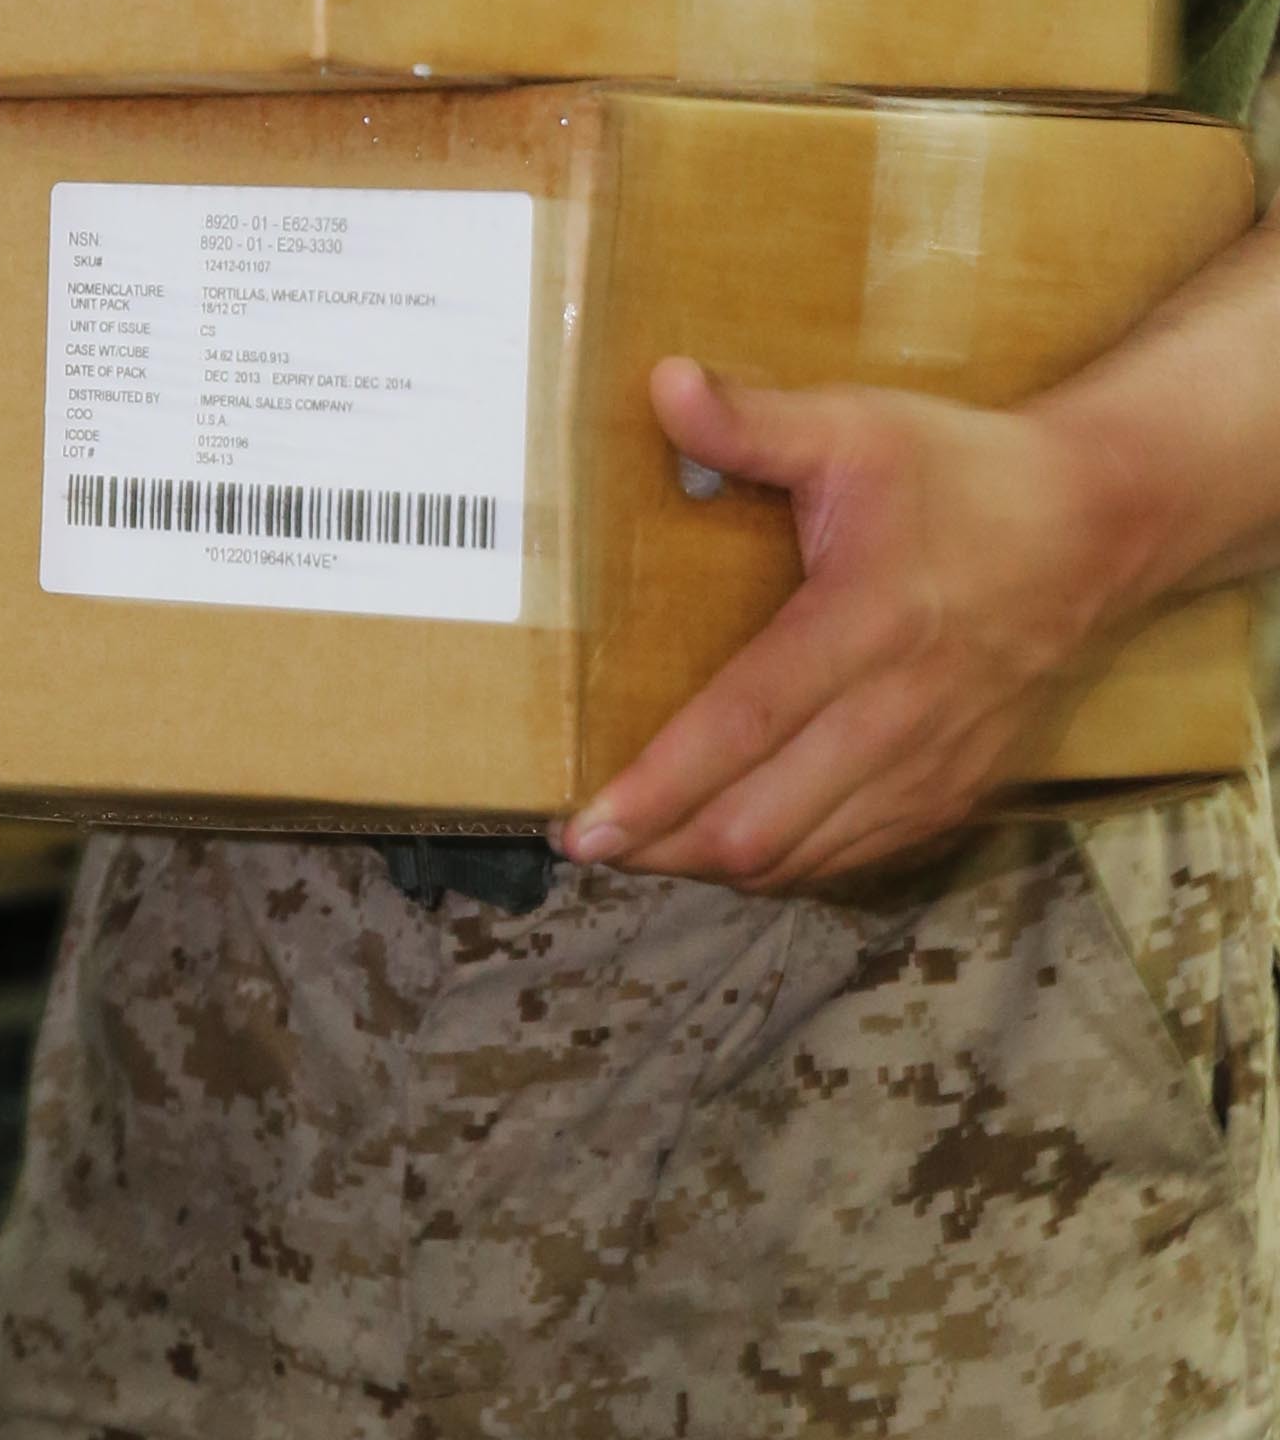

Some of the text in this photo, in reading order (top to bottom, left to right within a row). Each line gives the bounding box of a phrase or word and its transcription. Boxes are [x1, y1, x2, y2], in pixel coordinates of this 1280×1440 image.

[205, 214, 239, 231] 8920
[251, 215, 268, 232] 01
[200, 235, 232, 251] 8920
[246, 236, 262, 253] 01
[277, 237, 343, 255] E29-3330
[73, 255, 102, 269] SKU#
[67, 282, 164, 298] NOMENCLATURE
[202, 286, 269, 303] TORTILLAS,
[271, 289, 316, 305] WHEAT
[389, 293, 402, 307] 10
[404, 293, 437, 308] INCH
[70, 297, 131, 312] UNIT PACK
[201, 302, 248, 317] 18/12 CT
[70, 319, 152, 336] UNIT OF ISSUE
[200, 324, 216, 338] CS
[65, 343, 150, 359] CASE WT/CUBE
[65, 363, 147, 380] DATE OF PACK
[204, 369, 228, 383] DEC
[234, 370, 261, 384] 2013
[272, 372, 314, 387] EXPIRY
[354, 375, 379, 390] DEC
[385, 376, 412, 391] 2014
[68, 388, 161, 405] DISTRIBUTED BY
[200, 394, 354, 414] IMPERIAL SALES COMPANY
[66, 407, 93, 421] COO
[65, 428, 100, 443] ICODE
[62, 445, 86, 459] LOT
[195, 451, 234, 466] 354-13
